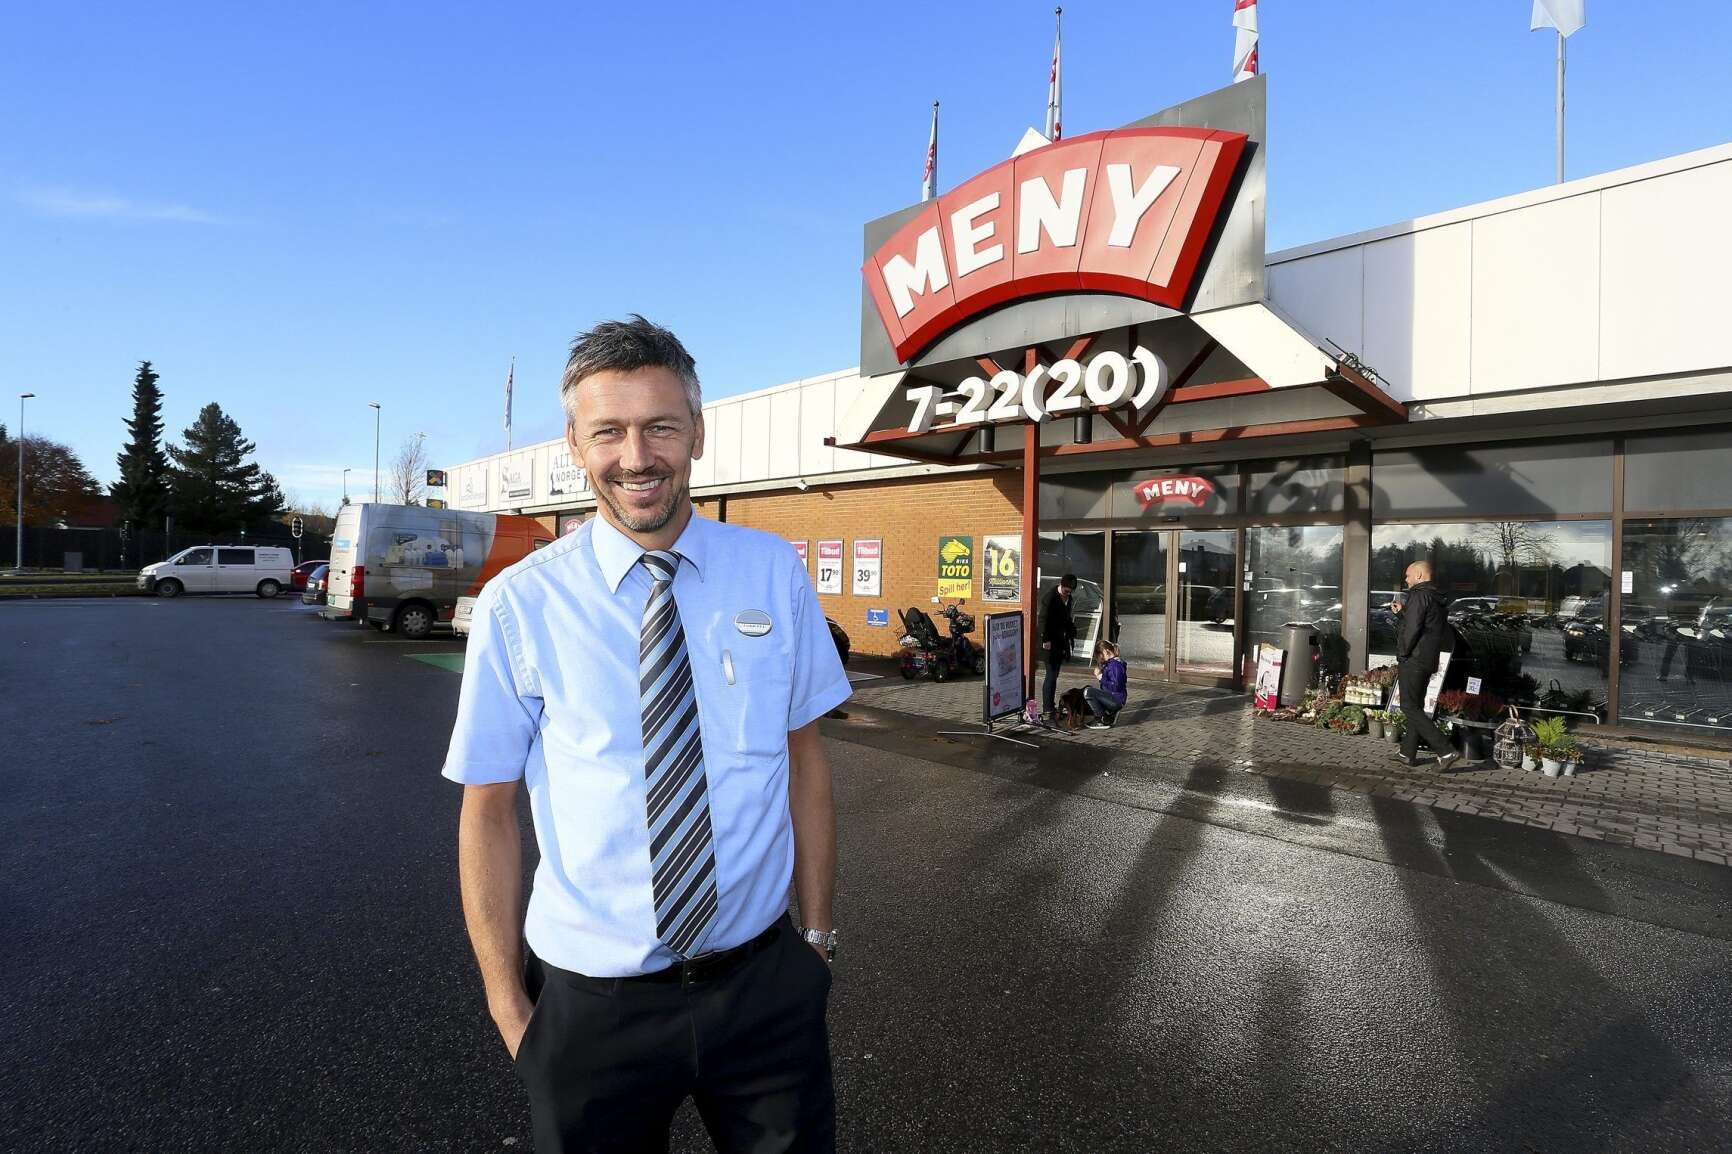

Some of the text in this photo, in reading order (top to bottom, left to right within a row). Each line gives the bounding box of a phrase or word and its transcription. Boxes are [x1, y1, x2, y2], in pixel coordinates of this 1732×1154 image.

[882, 162, 1182, 319] MENY
[556, 468, 581, 482] NORGE
[1143, 479, 1205, 501] MENY
[989, 546, 1015, 577] 16
[941, 565, 970, 577] TOTO
[939, 583, 955, 596] Spill
